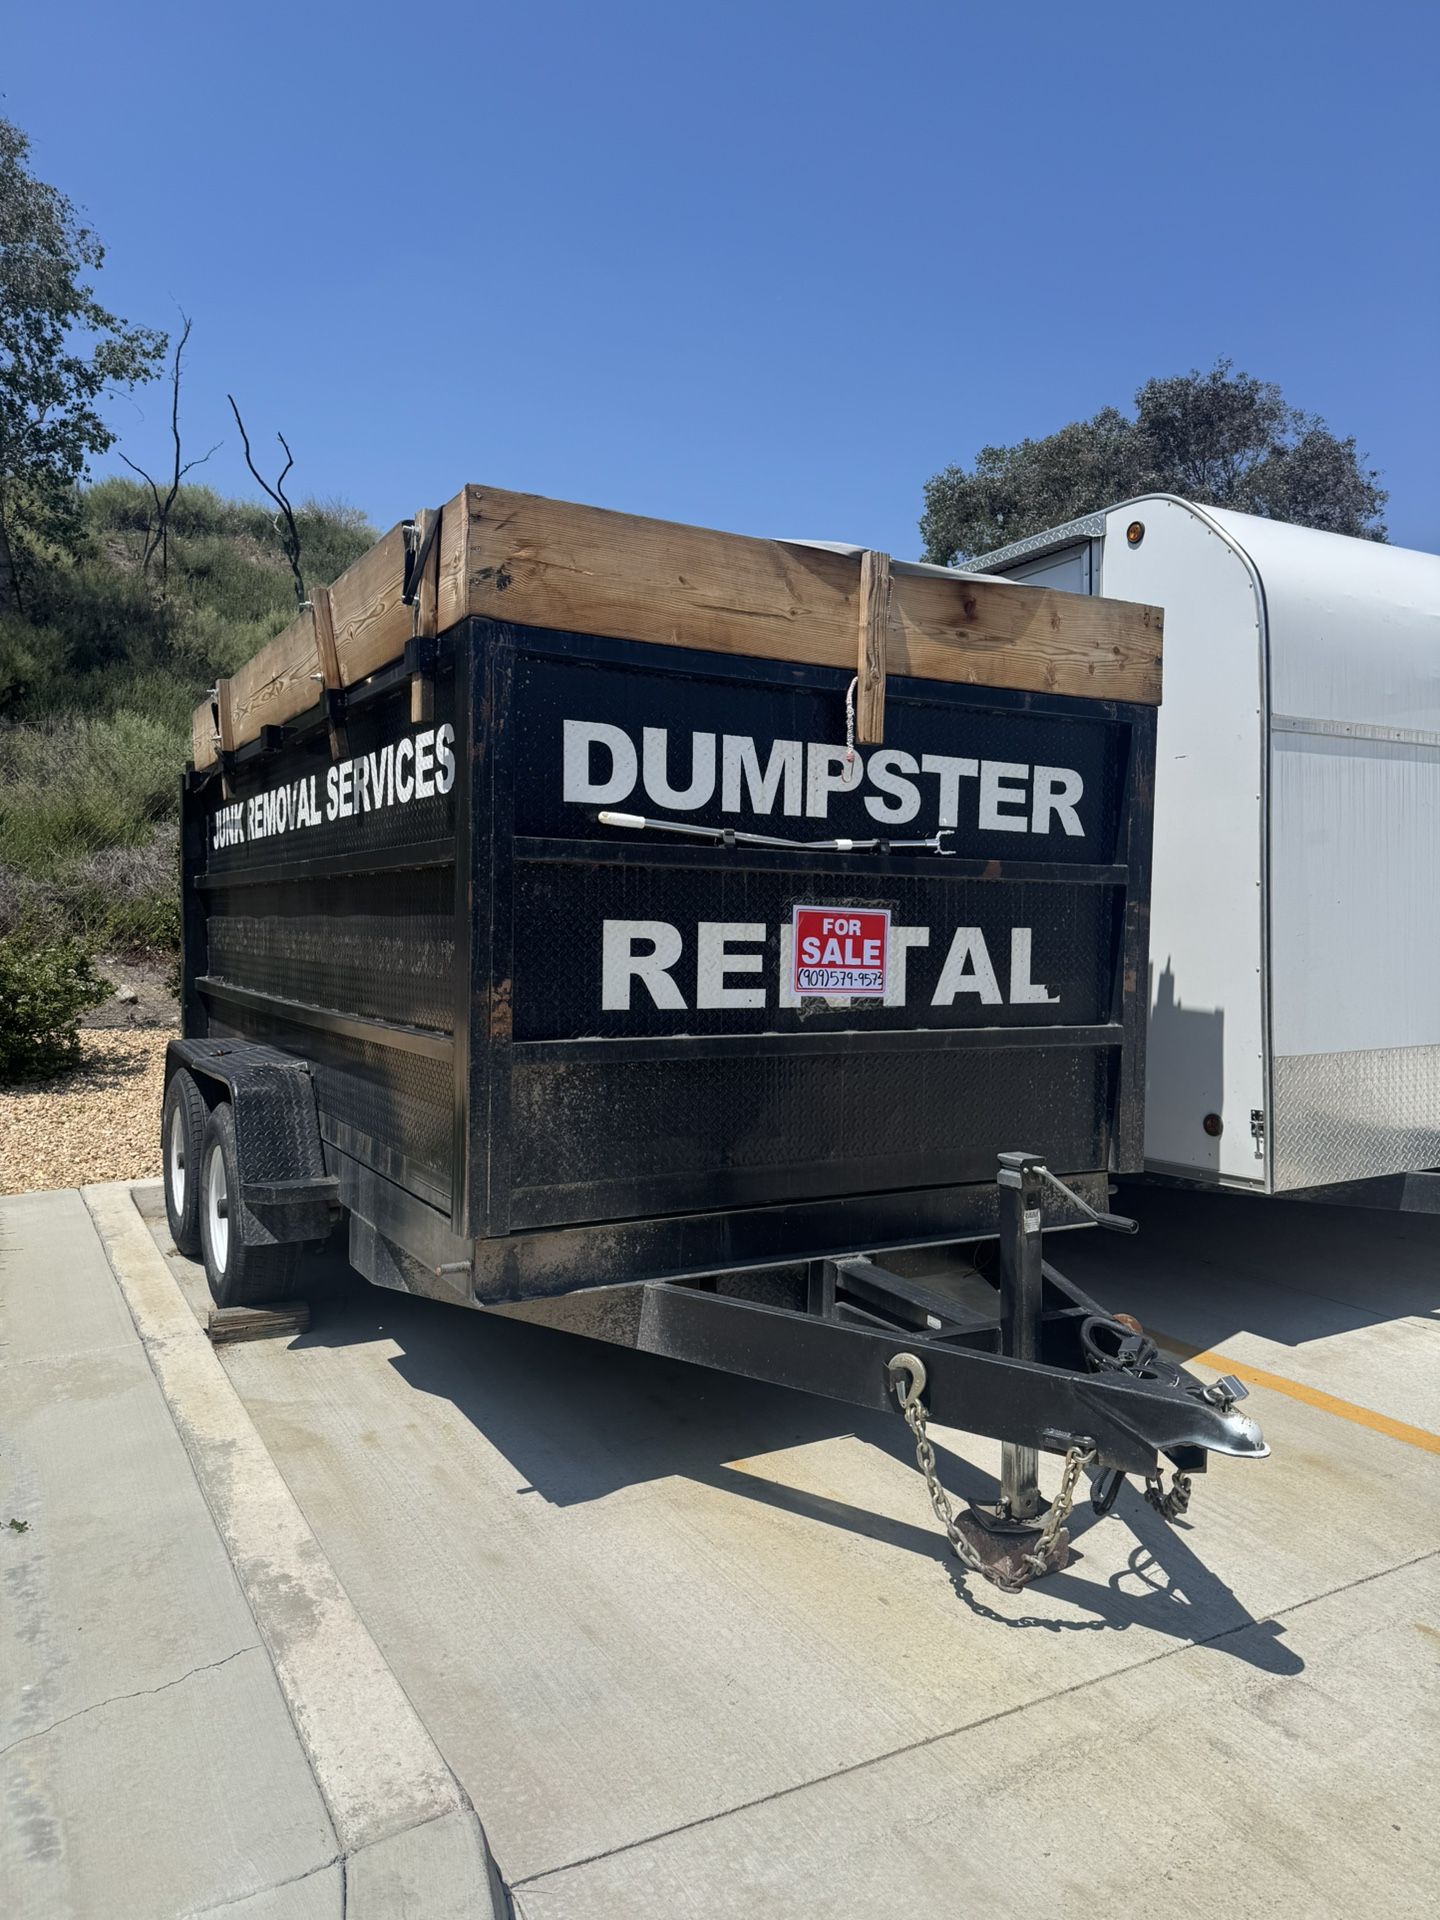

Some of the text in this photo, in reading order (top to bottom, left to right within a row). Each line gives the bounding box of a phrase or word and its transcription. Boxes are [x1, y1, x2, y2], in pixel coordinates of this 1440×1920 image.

[213, 723, 456, 850] JUNK REMOVAL SERVICES
[563, 719, 1085, 837] DUMPSTER
[801, 937, 881, 966] SALE
[822, 918, 862, 936] FOR
